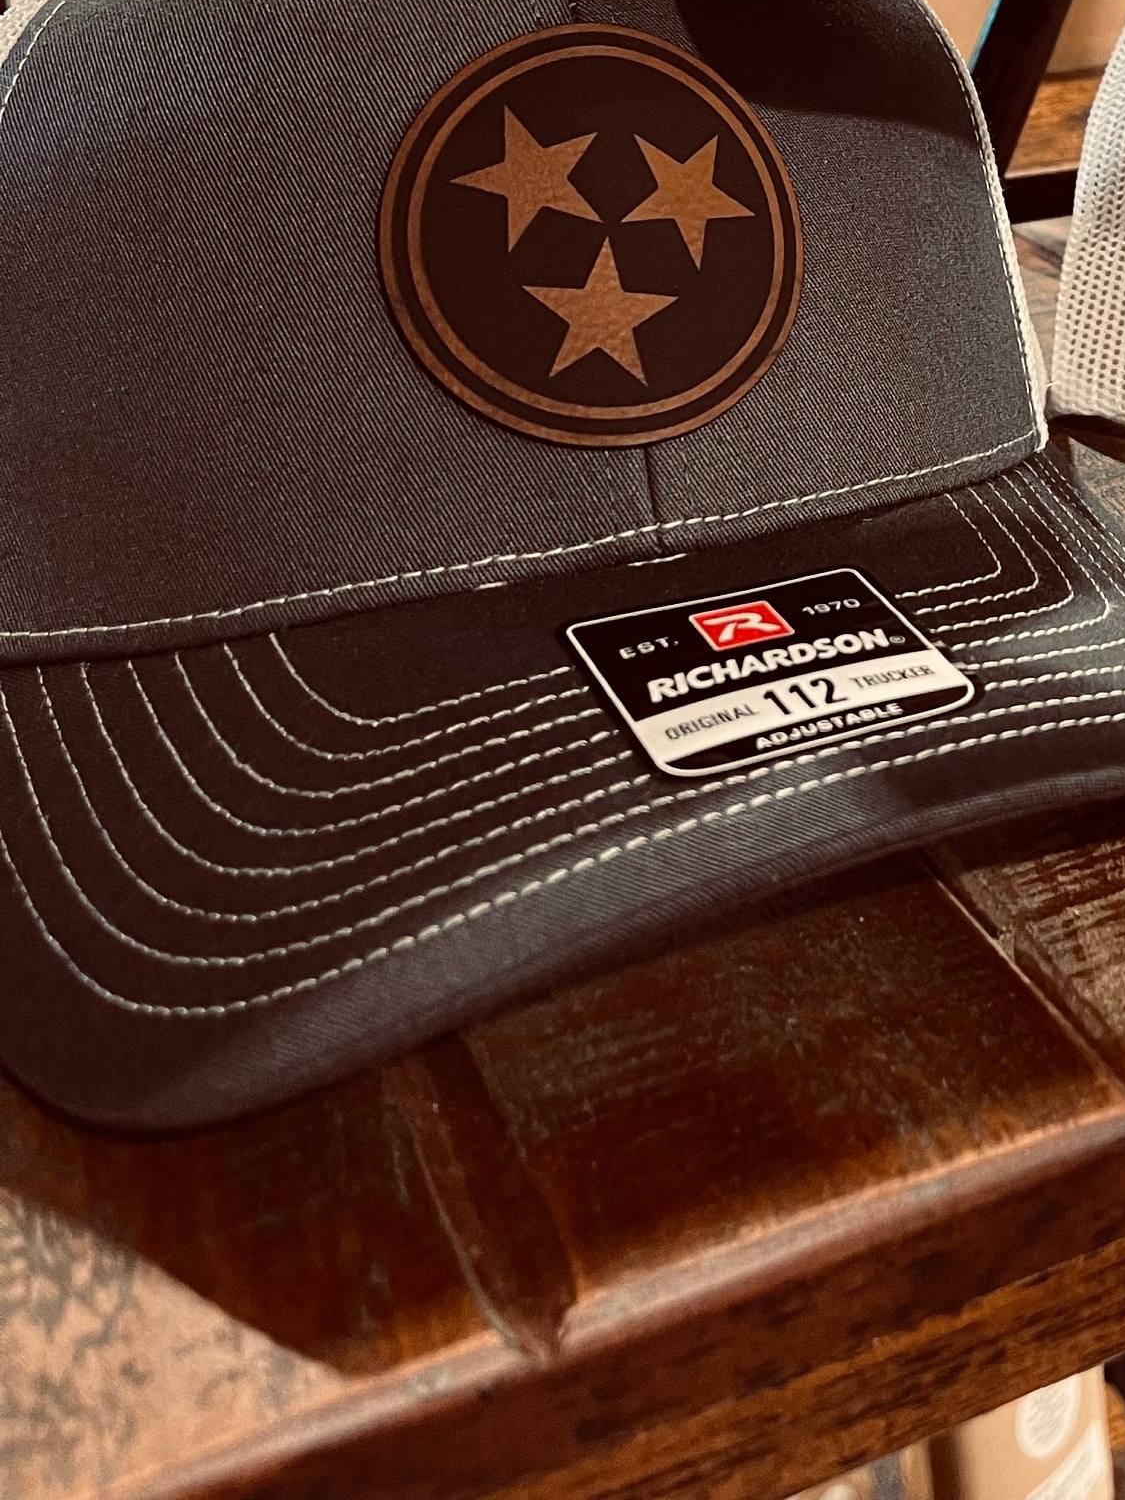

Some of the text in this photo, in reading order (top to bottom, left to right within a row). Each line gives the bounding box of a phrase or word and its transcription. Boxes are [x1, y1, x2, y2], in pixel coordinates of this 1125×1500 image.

[619, 598, 861, 660] EST. 1970
[702, 612, 781, 643] R
[647, 629, 889, 704] RICHARDSON
[664, 665, 936, 741] ORIGINAL 112 TRUCKER
[755, 702, 904, 751] ADJUSTABLE
